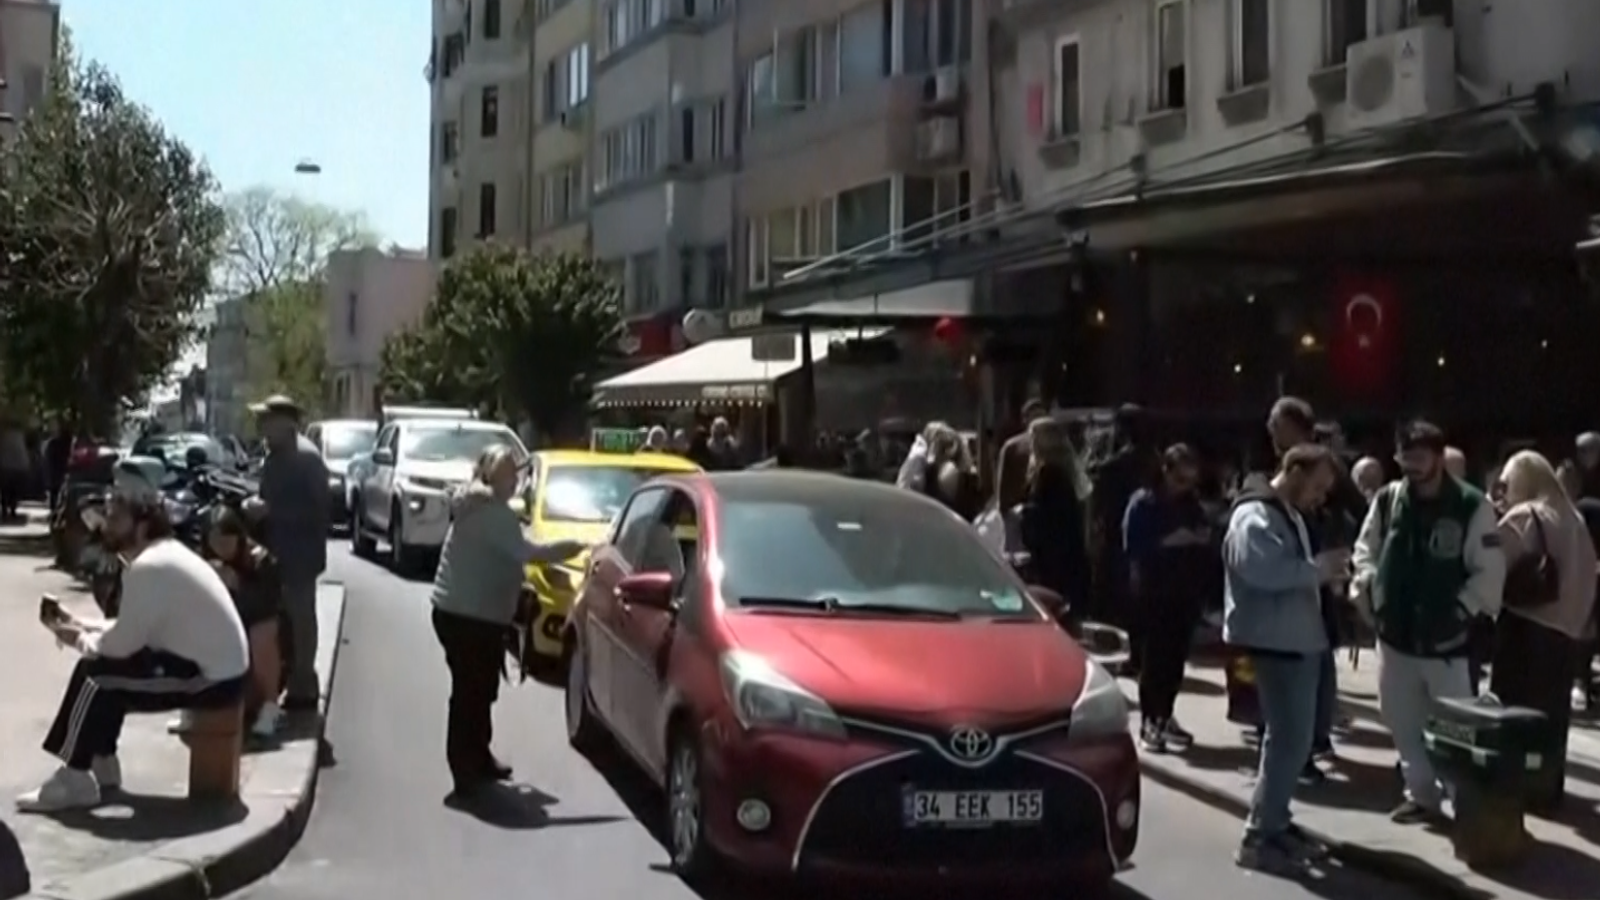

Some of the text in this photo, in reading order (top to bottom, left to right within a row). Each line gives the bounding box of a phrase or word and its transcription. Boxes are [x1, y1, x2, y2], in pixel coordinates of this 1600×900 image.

[917, 793, 1041, 818] 34 EEK 155
